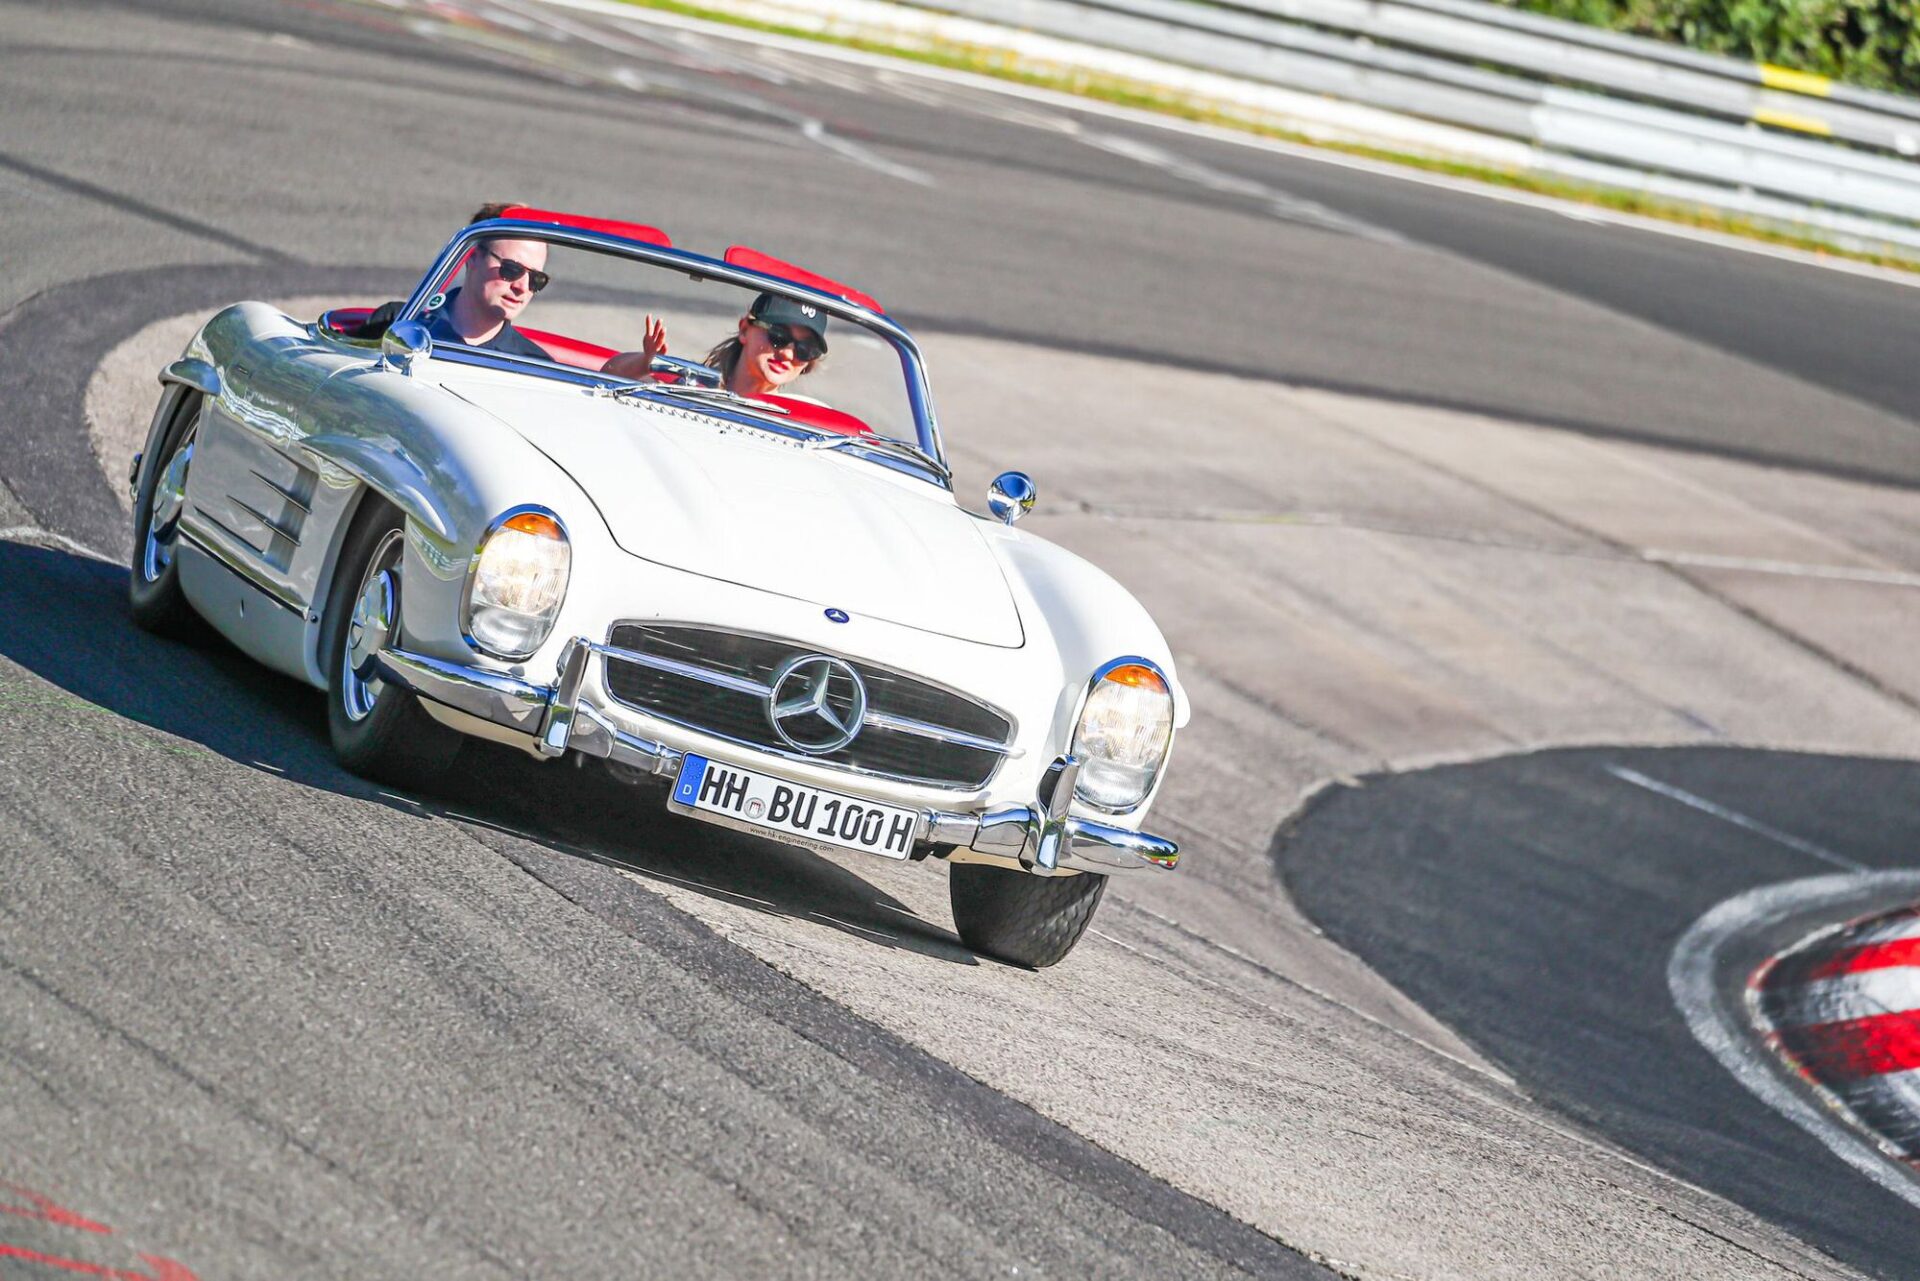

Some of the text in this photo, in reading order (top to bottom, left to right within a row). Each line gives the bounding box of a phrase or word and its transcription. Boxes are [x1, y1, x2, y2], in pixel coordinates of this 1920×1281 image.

[683, 784, 693, 796] D
[700, 766, 750, 811] HH
[767, 785, 817, 831] BU
[750, 827, 834, 853] www.hk-engineering.com
